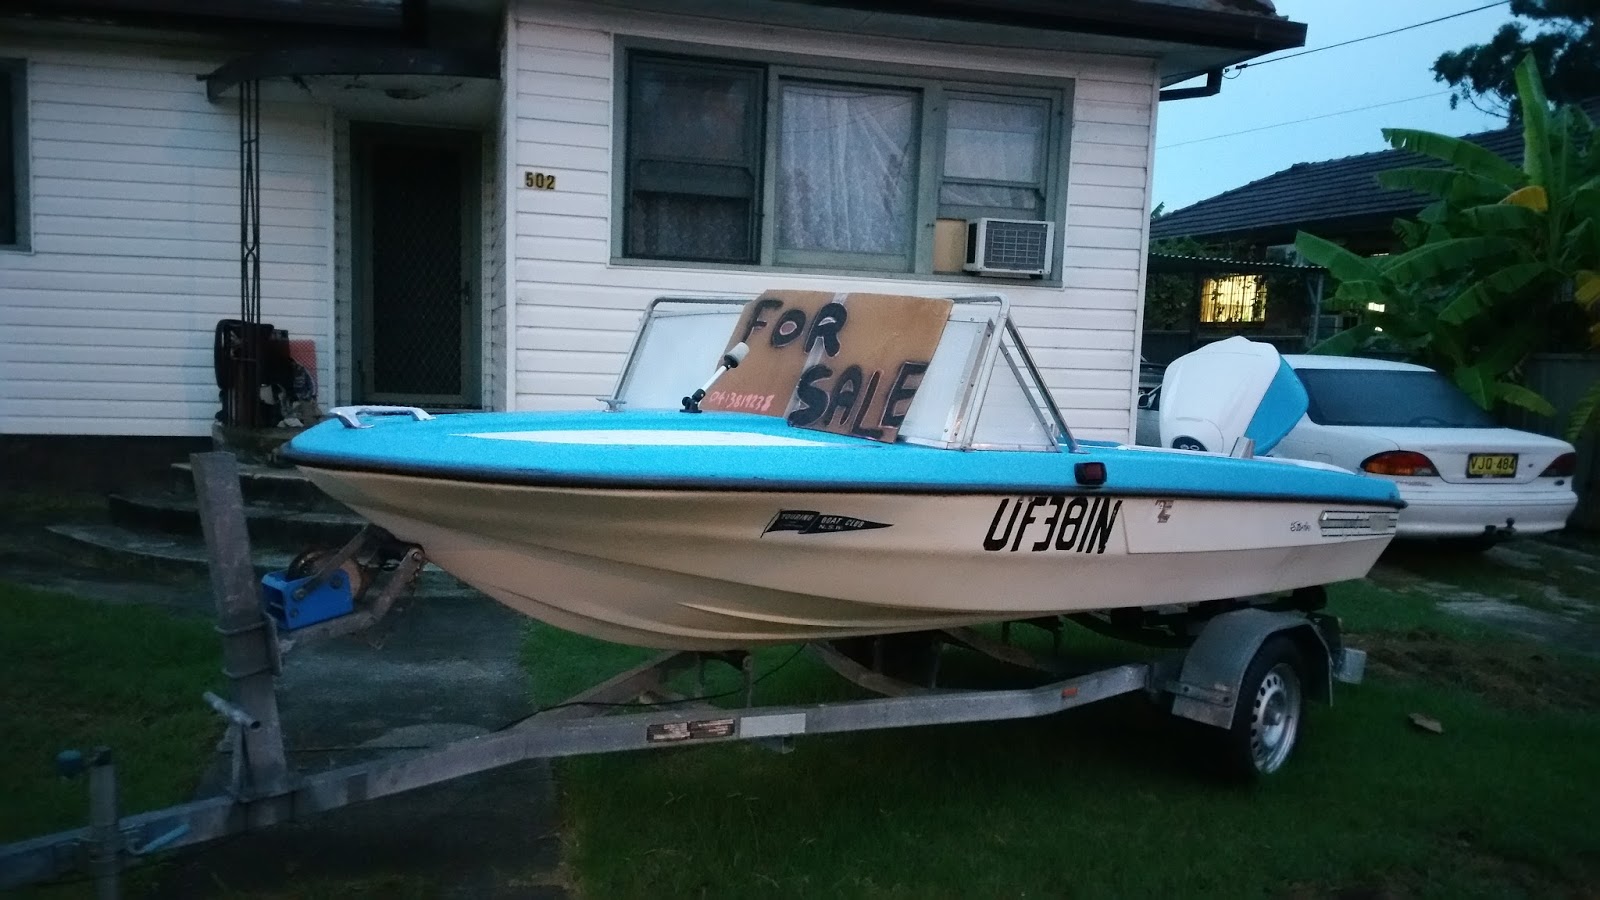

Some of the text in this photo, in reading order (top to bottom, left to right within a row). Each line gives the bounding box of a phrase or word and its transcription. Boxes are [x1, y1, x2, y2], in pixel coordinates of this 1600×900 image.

[526, 171, 555, 190] 502
[742, 299, 848, 358] FOR
[787, 361, 929, 439] SALE
[781, 513, 865, 528] TOURING BOAT CLUB
